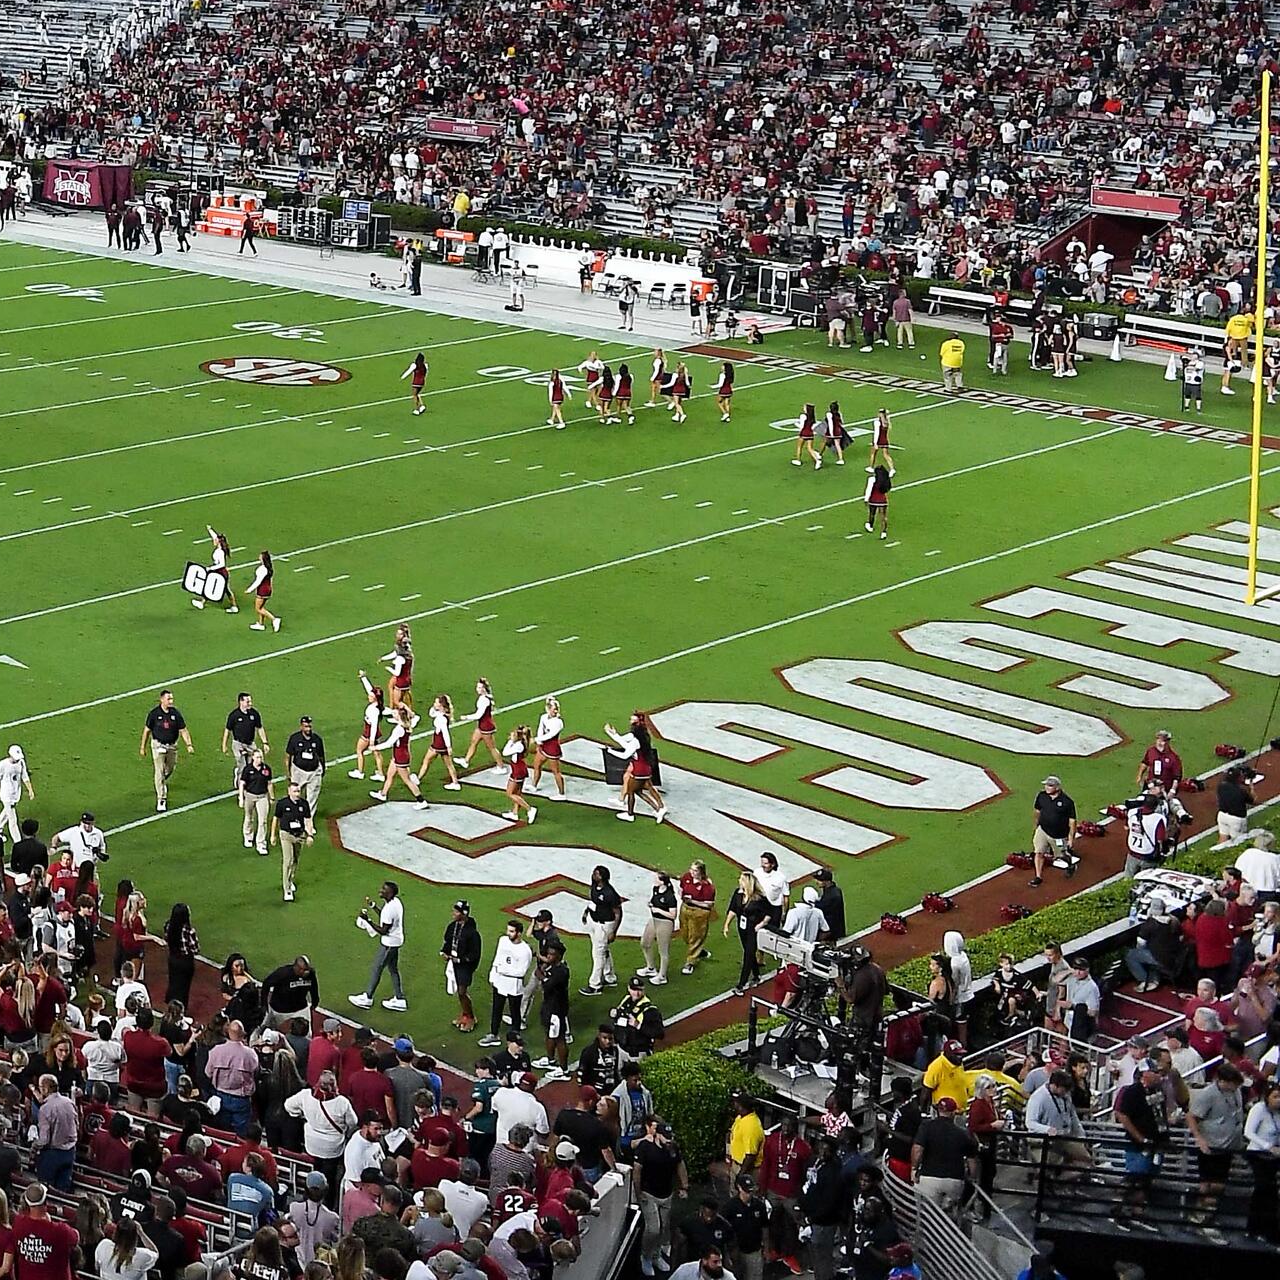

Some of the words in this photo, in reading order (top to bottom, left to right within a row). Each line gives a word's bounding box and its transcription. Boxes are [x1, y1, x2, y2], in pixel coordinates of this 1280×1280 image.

[60, 181, 86, 197] STATE
[209, 358, 341, 386] SEC
[746, 355, 832, 372] THE
[1104, 412, 1251, 442] CLUB
[184, 564, 226, 602] GO
[1131, 835, 1143, 850] 71
[504, 1194, 524, 1212] 22
[23, 1237, 43, 1246] ANTI
